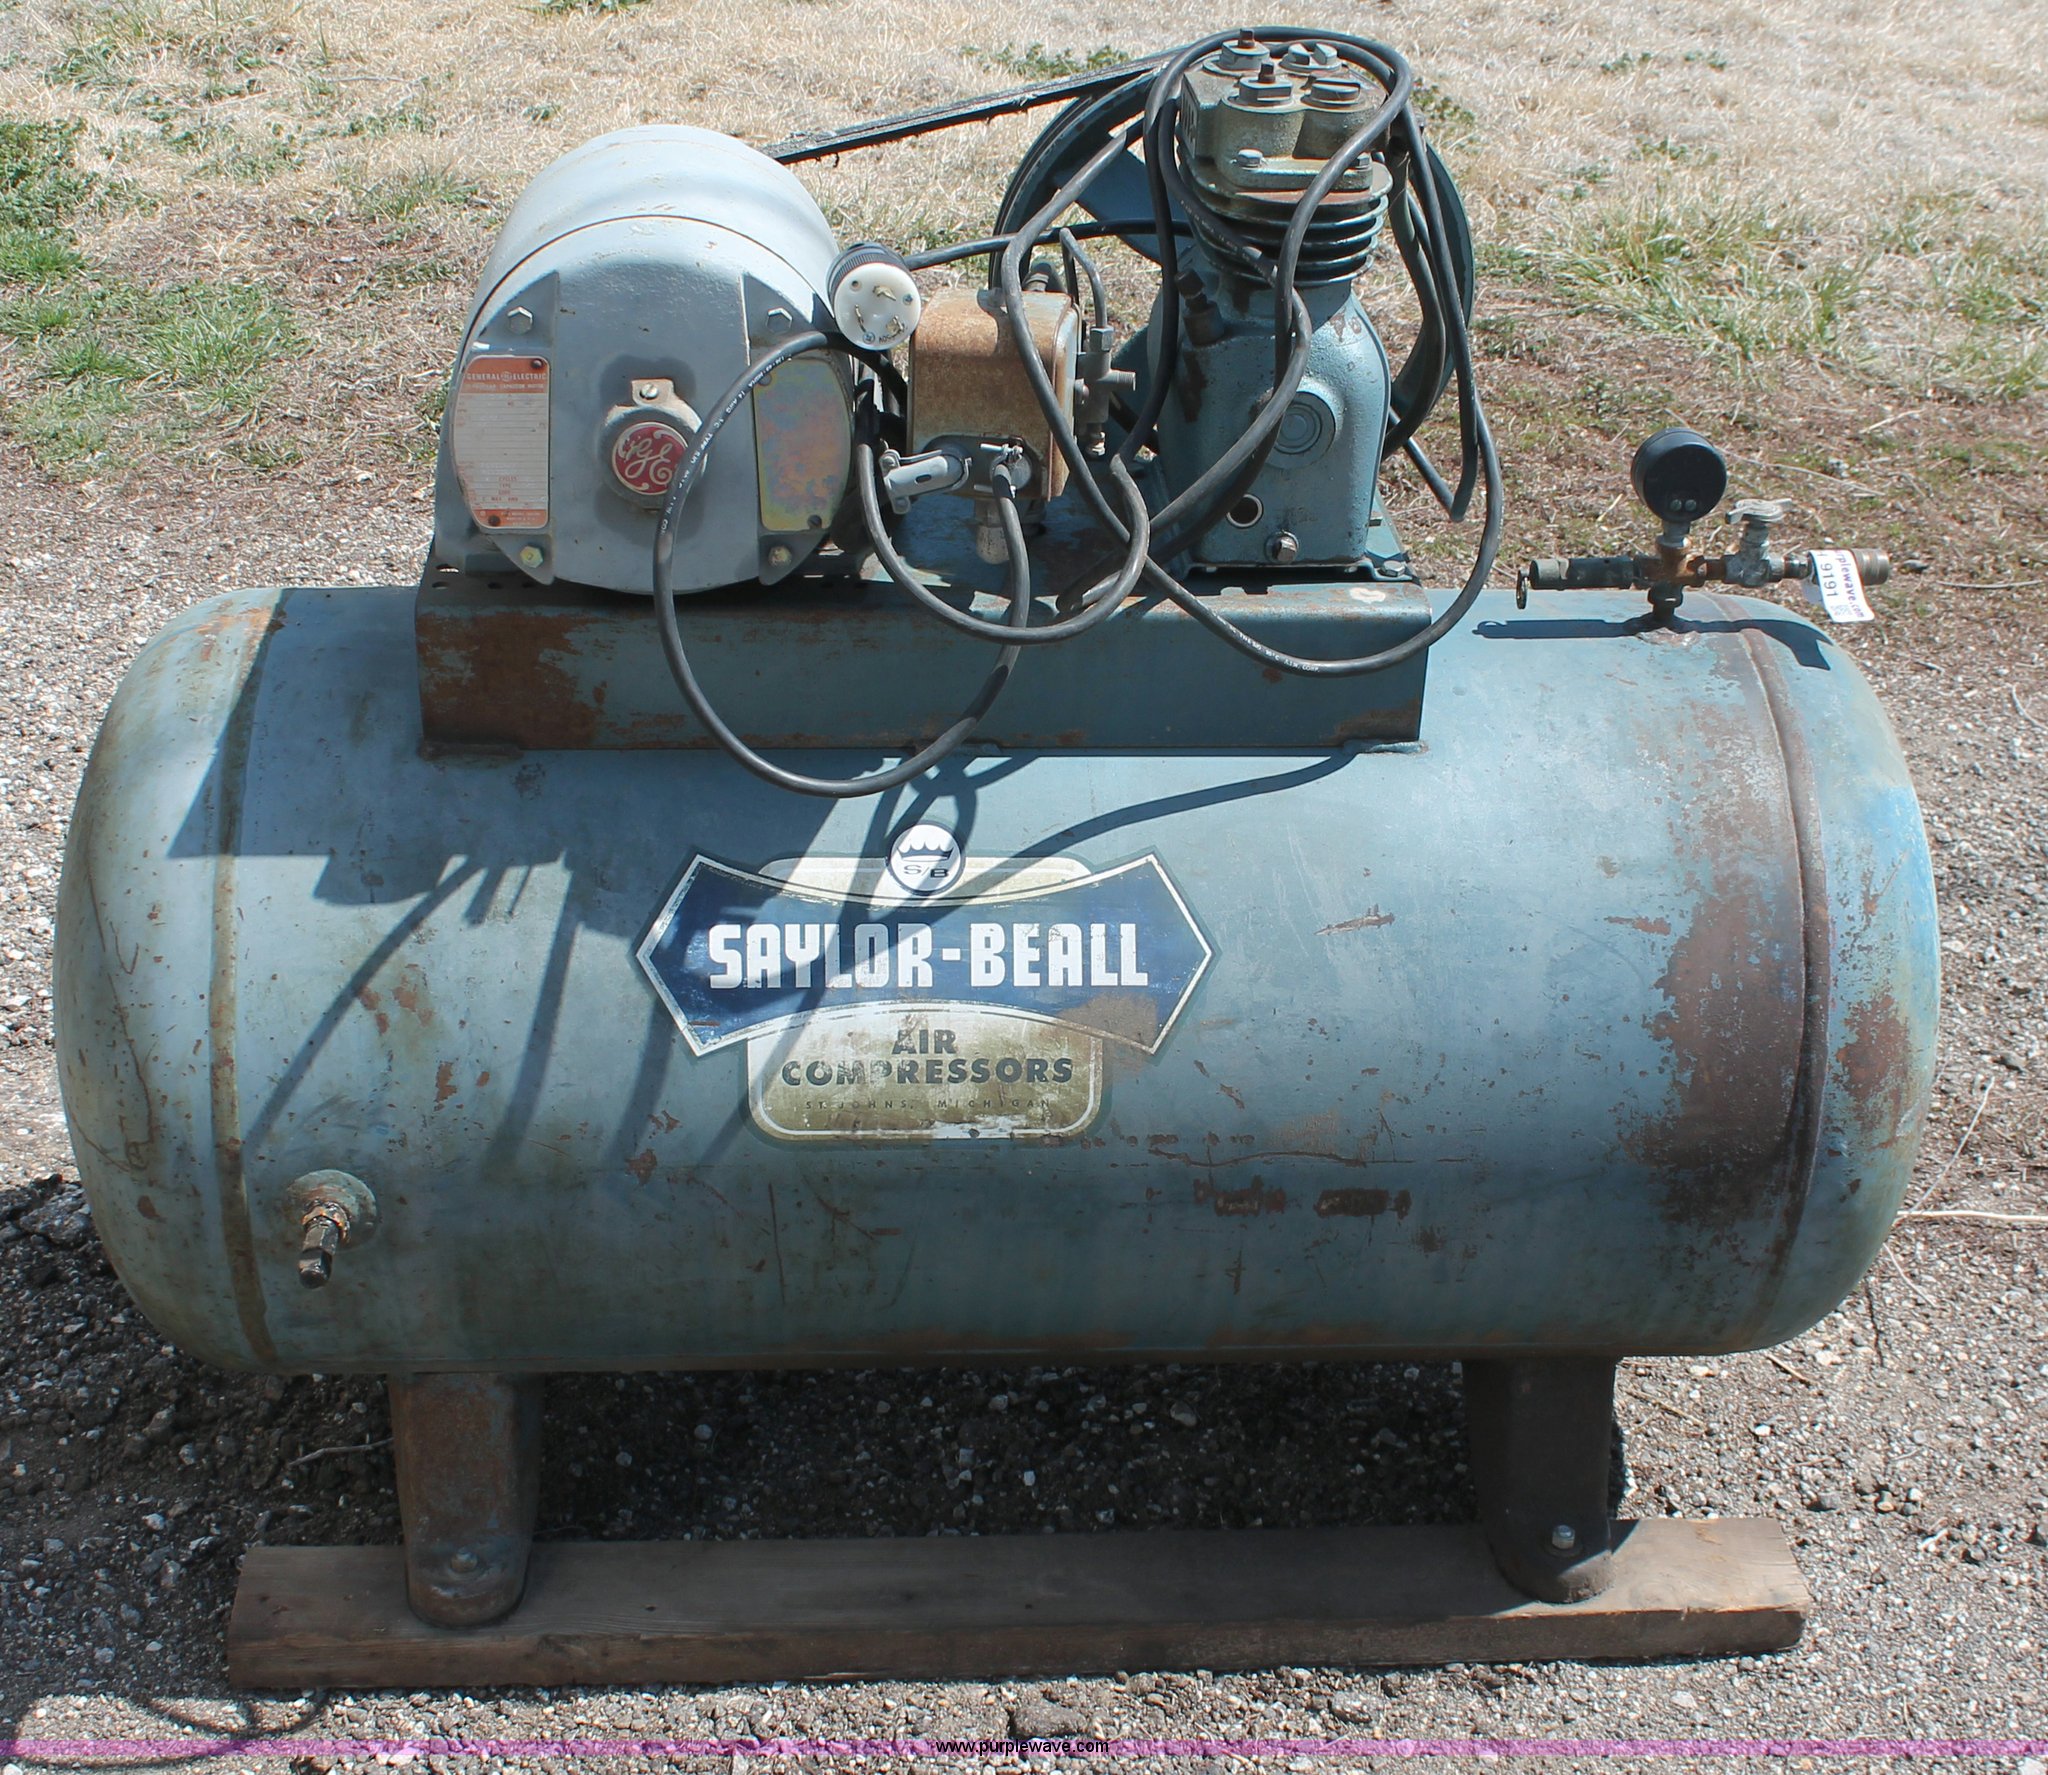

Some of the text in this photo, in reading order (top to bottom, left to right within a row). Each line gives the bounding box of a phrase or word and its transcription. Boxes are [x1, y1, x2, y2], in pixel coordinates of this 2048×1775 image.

[466, 372, 547, 380] GENERAL ELECTRIC
[1820, 562, 1840, 597] 9191
[708, 922, 1149, 990] SAYLOR-BEALL
[891, 1029, 958, 1055] AIR
[781, 1057, 1074, 1087] COMPRESSORS
[936, 1098, 1050, 1109] MICHIGAN
